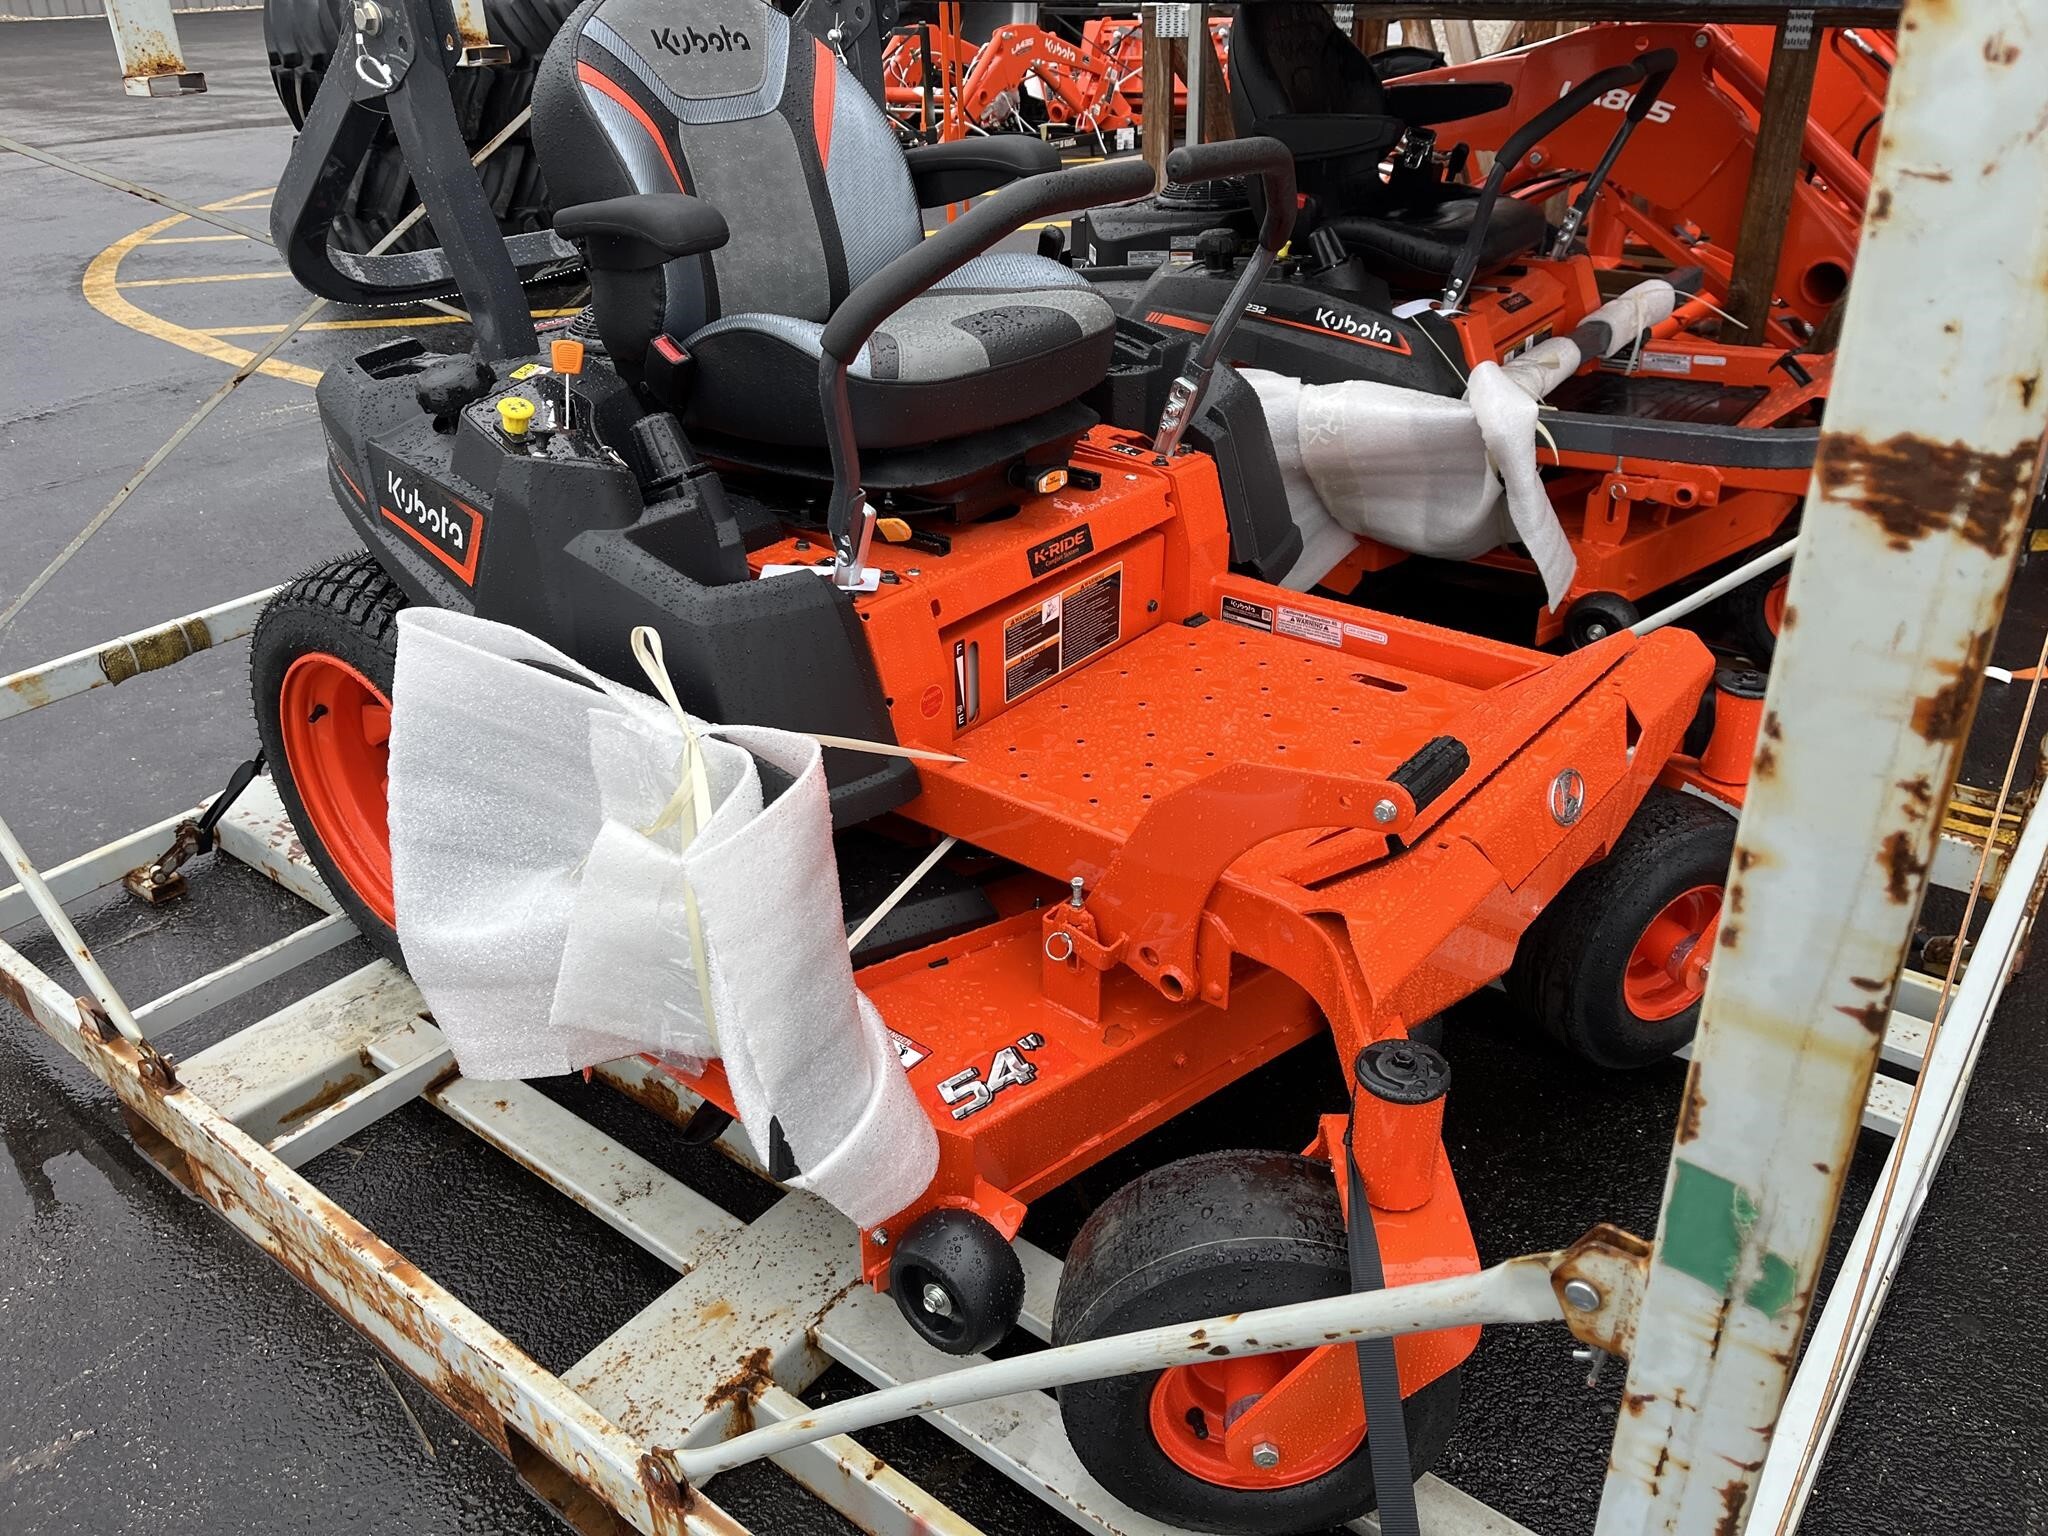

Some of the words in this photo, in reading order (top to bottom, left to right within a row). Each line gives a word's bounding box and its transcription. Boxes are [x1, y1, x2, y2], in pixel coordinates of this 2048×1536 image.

[651, 24, 751, 56] Kubota
[1044, 38, 1076, 62] Kubota
[1315, 307, 1392, 344] Kubota
[388, 470, 463, 549] Kubota
[1034, 530, 1085, 564] K-RIDE
[1230, 600, 1256, 613] Kubota
[1283, 608, 1304, 618] California
[1295, 616, 1323, 629] WARNING
[956, 643, 963, 655] F
[958, 713, 965, 725] E
[937, 1032, 1045, 1121] 54"
